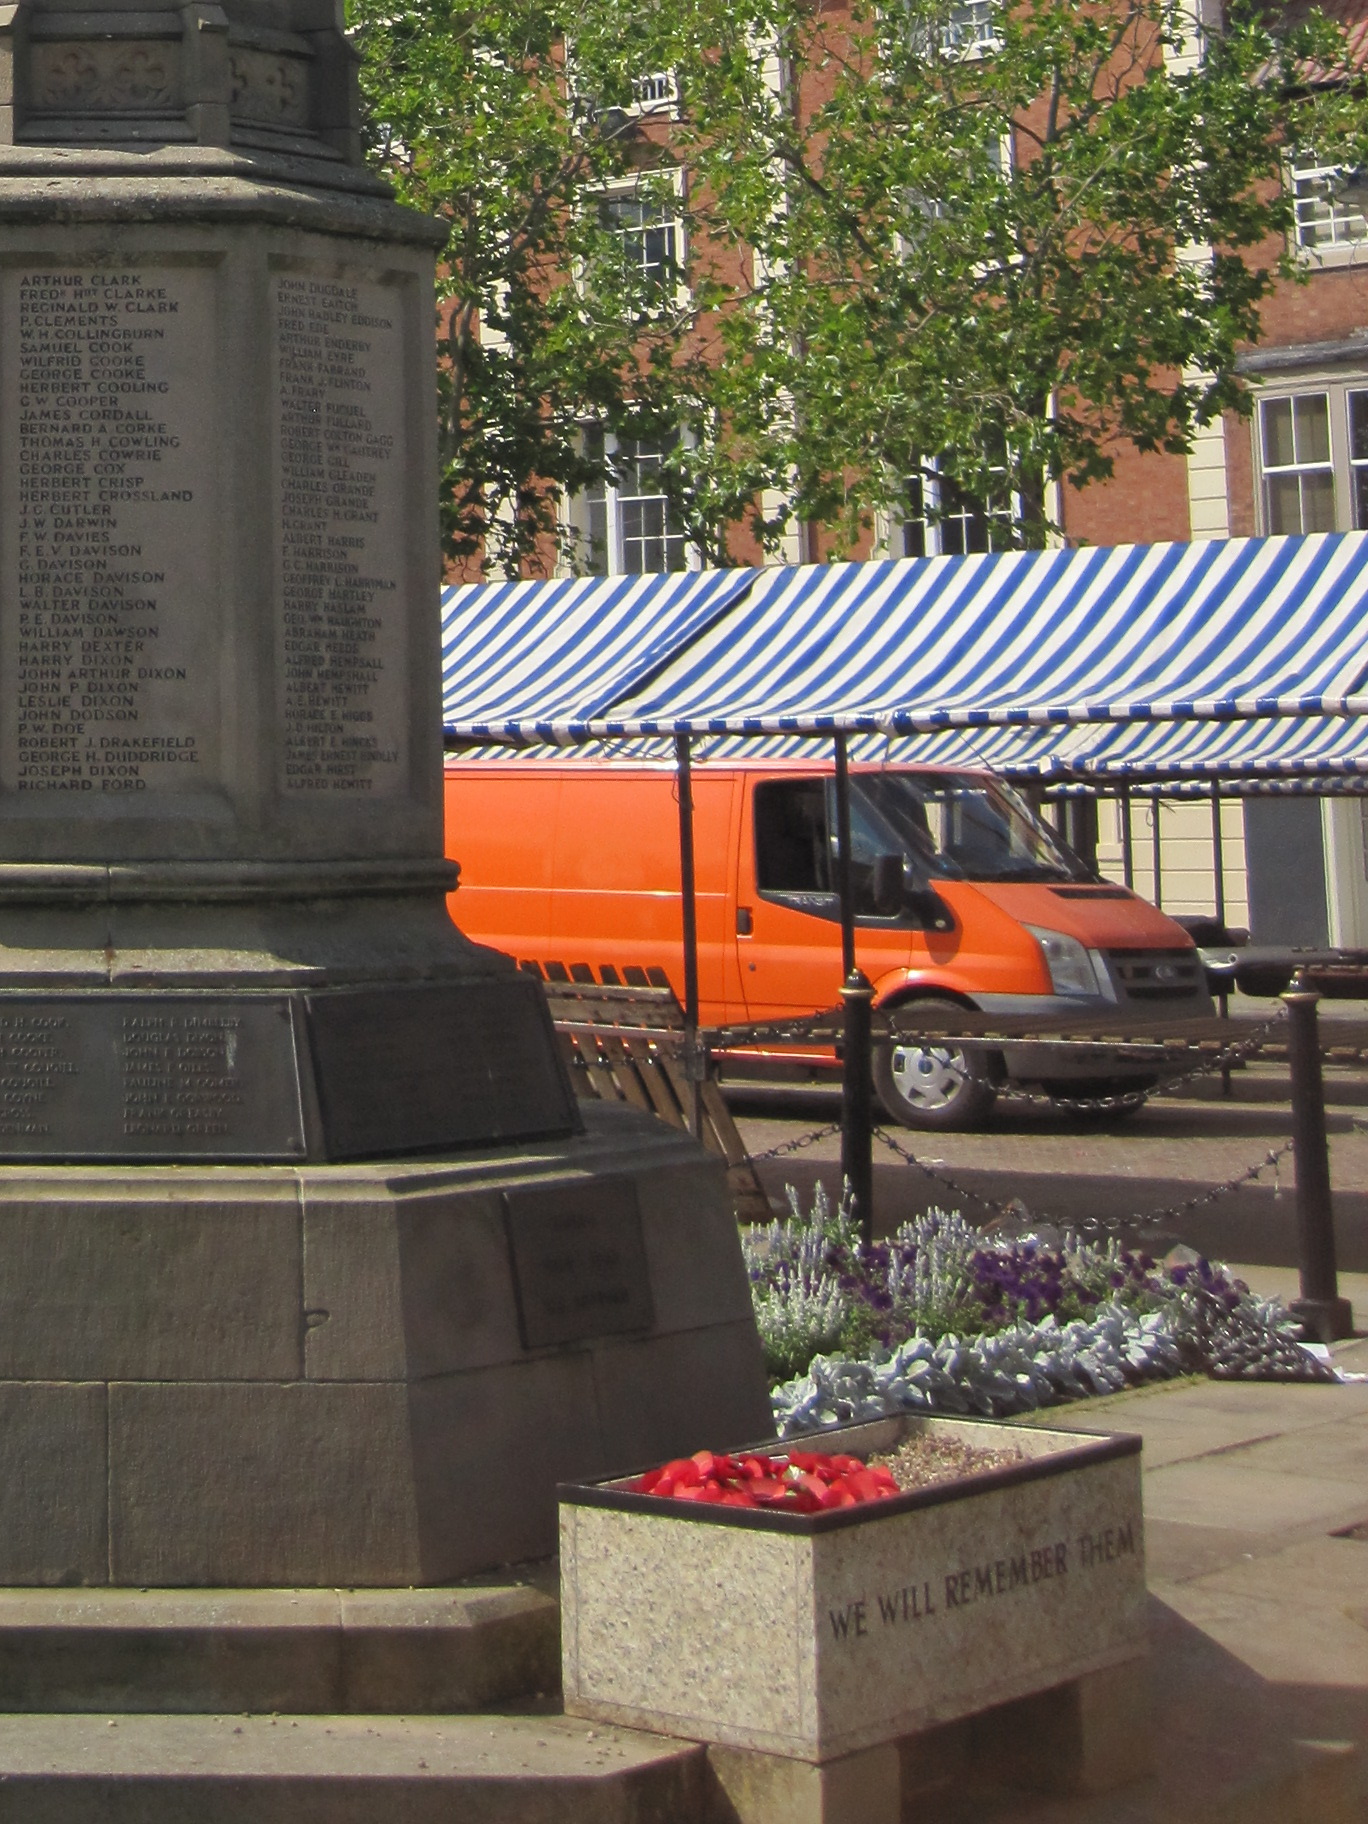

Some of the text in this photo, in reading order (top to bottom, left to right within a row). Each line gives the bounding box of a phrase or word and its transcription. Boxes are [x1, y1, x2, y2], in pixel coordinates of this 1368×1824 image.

[21, 275, 141, 286] ARTHUR CLARK
[279, 279, 357, 298] JOHN DUGDALE
[279, 306, 304, 318] JOHN
[352, 315, 393, 329] EDDISON
[20, 342, 134, 353] SAMUEL COOK
[280, 334, 371, 351] ARTHUR ENDERBY
[280, 346, 354, 363] WILLIAM EYRE
[21, 356, 145, 367] WILFRID COOKE
[20, 382, 169, 393] HERBERT COOLING
[20, 410, 152, 421] JAMES CORDALL
[20, 424, 92, 434] BERNARD
[116, 424, 167, 434] CORKE
[21, 437, 84, 447] THOMAS
[109, 437, 180, 447] COWLING
[20, 450, 161, 461] CHARLES COWRIE
[20, 464, 126, 474] GEORGE COX
[20, 477, 144, 488] HERBERT CRISP
[282, 479, 327, 492] CHARLES
[282, 493, 321, 504] JOSEPH
[283, 534, 365, 548] ALBERT HARRIS
[19, 572, 165, 583] HORACE DAVISON
[284, 588, 374, 601] GEORGE HARTLEY
[21, 600, 156, 610] WALTER DAVISON
[284, 600, 366, 613] HARRY HASLAM
[20, 628, 159, 638] WILLIAM DAWSON
[285, 627, 375, 641] ABRAHAM HEATH
[19, 641, 144, 652] HARRY DEXTER
[19, 656, 133, 665] HARRY DIXON
[285, 656, 325, 666] ALFRED
[18, 668, 186, 679] JOHN ARTHUR DIXON
[19, 696, 134, 707] LESLIE DIXON
[18, 710, 138, 720] JOHN DODSON
[18, 766, 139, 776] JOSEPH DIXON
[286, 764, 356, 775] EDGAR HIRST
[18, 780, 146, 790] RICHARD FORD
[287, 779, 373, 789] ALFRED HEWITT
[830, 1522, 1135, 1642] WE WILL REMEMBER THEM
